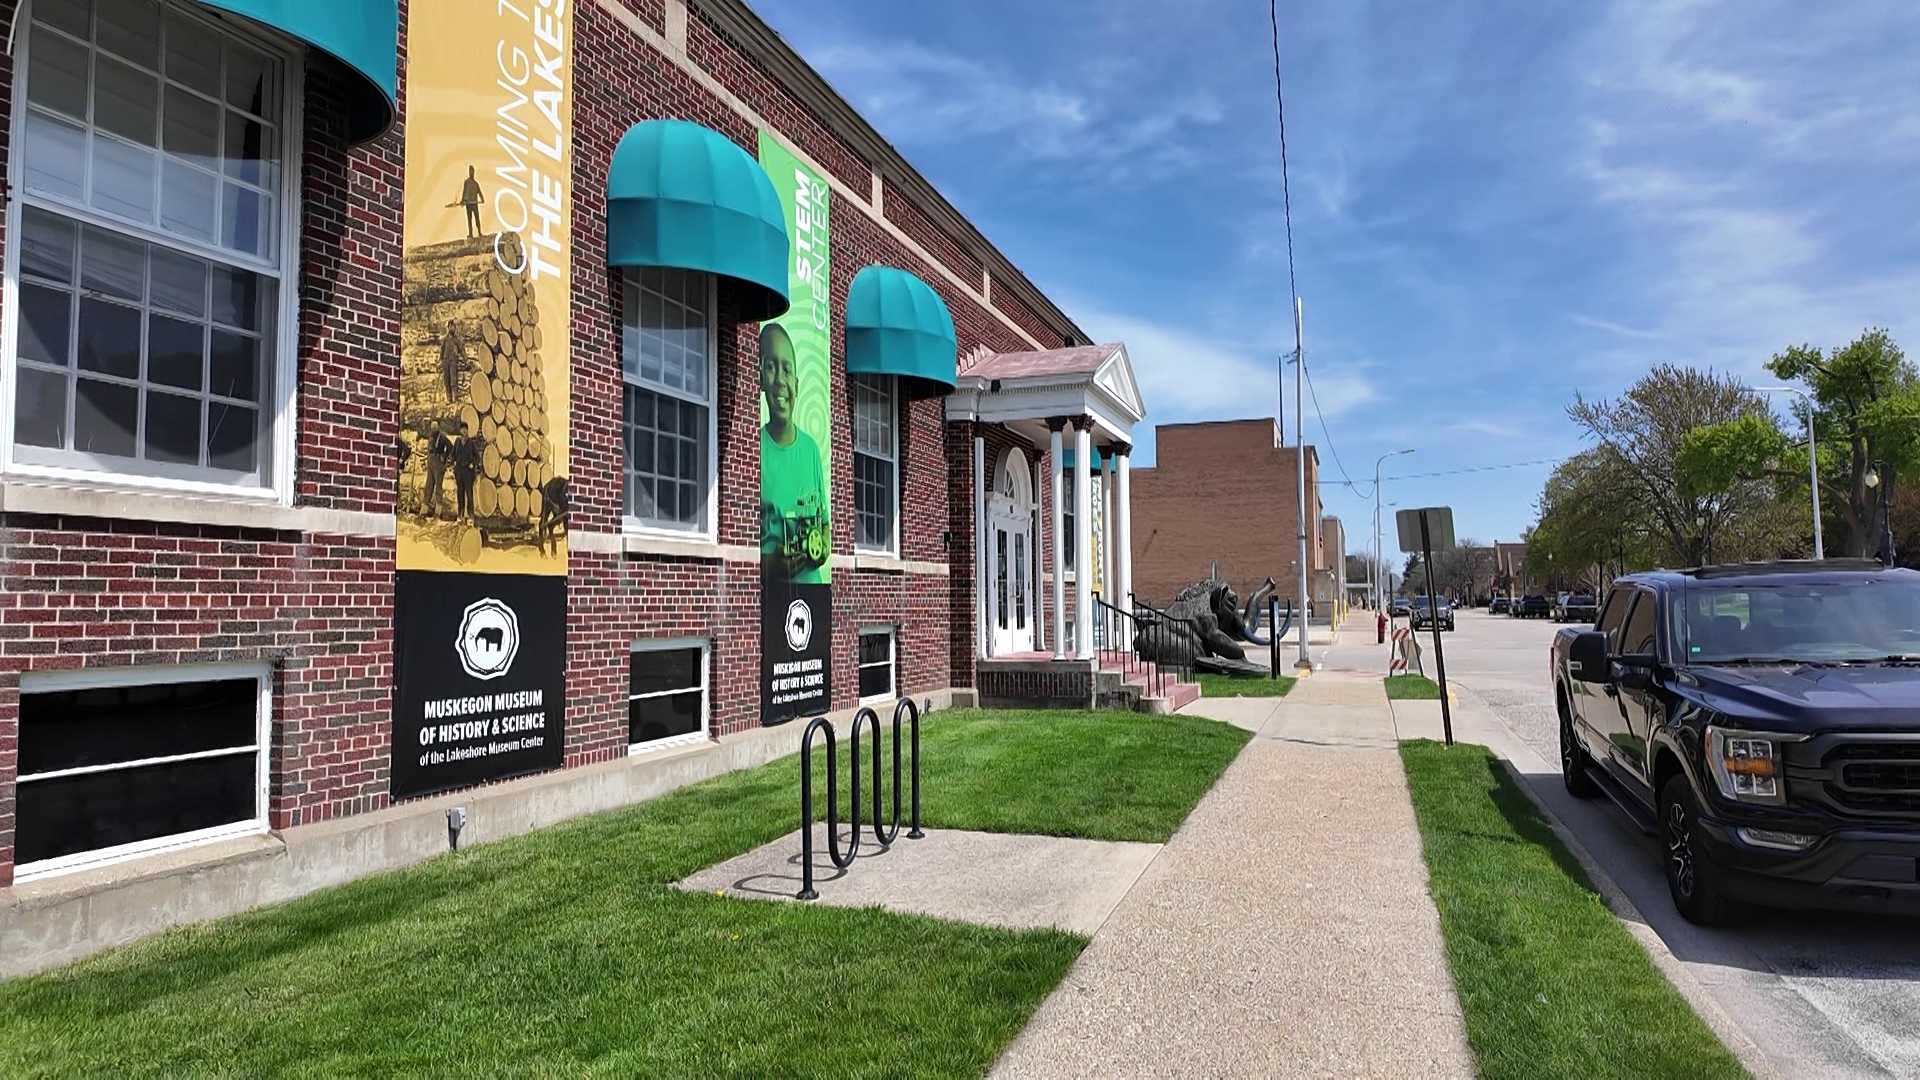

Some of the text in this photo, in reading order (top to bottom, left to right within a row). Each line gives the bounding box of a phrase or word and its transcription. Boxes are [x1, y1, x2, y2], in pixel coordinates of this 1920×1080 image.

[494, 39, 530, 275] COMING
[531, 168, 562, 281] THE
[795, 167, 812, 285] STEM
[811, 182, 828, 331] CENTER
[774, 658, 823, 676] MUSKEGON MUSEUM
[779, 677, 800, 690] HISTORY
[804, 673, 824, 686] SCIENCE
[424, 689, 543, 720] MUSKEGON MUSEUM
[419, 711, 545, 746] OF HISTORY & SCIENCE
[419, 735, 544, 766] of the Lakeshore Museum Center
